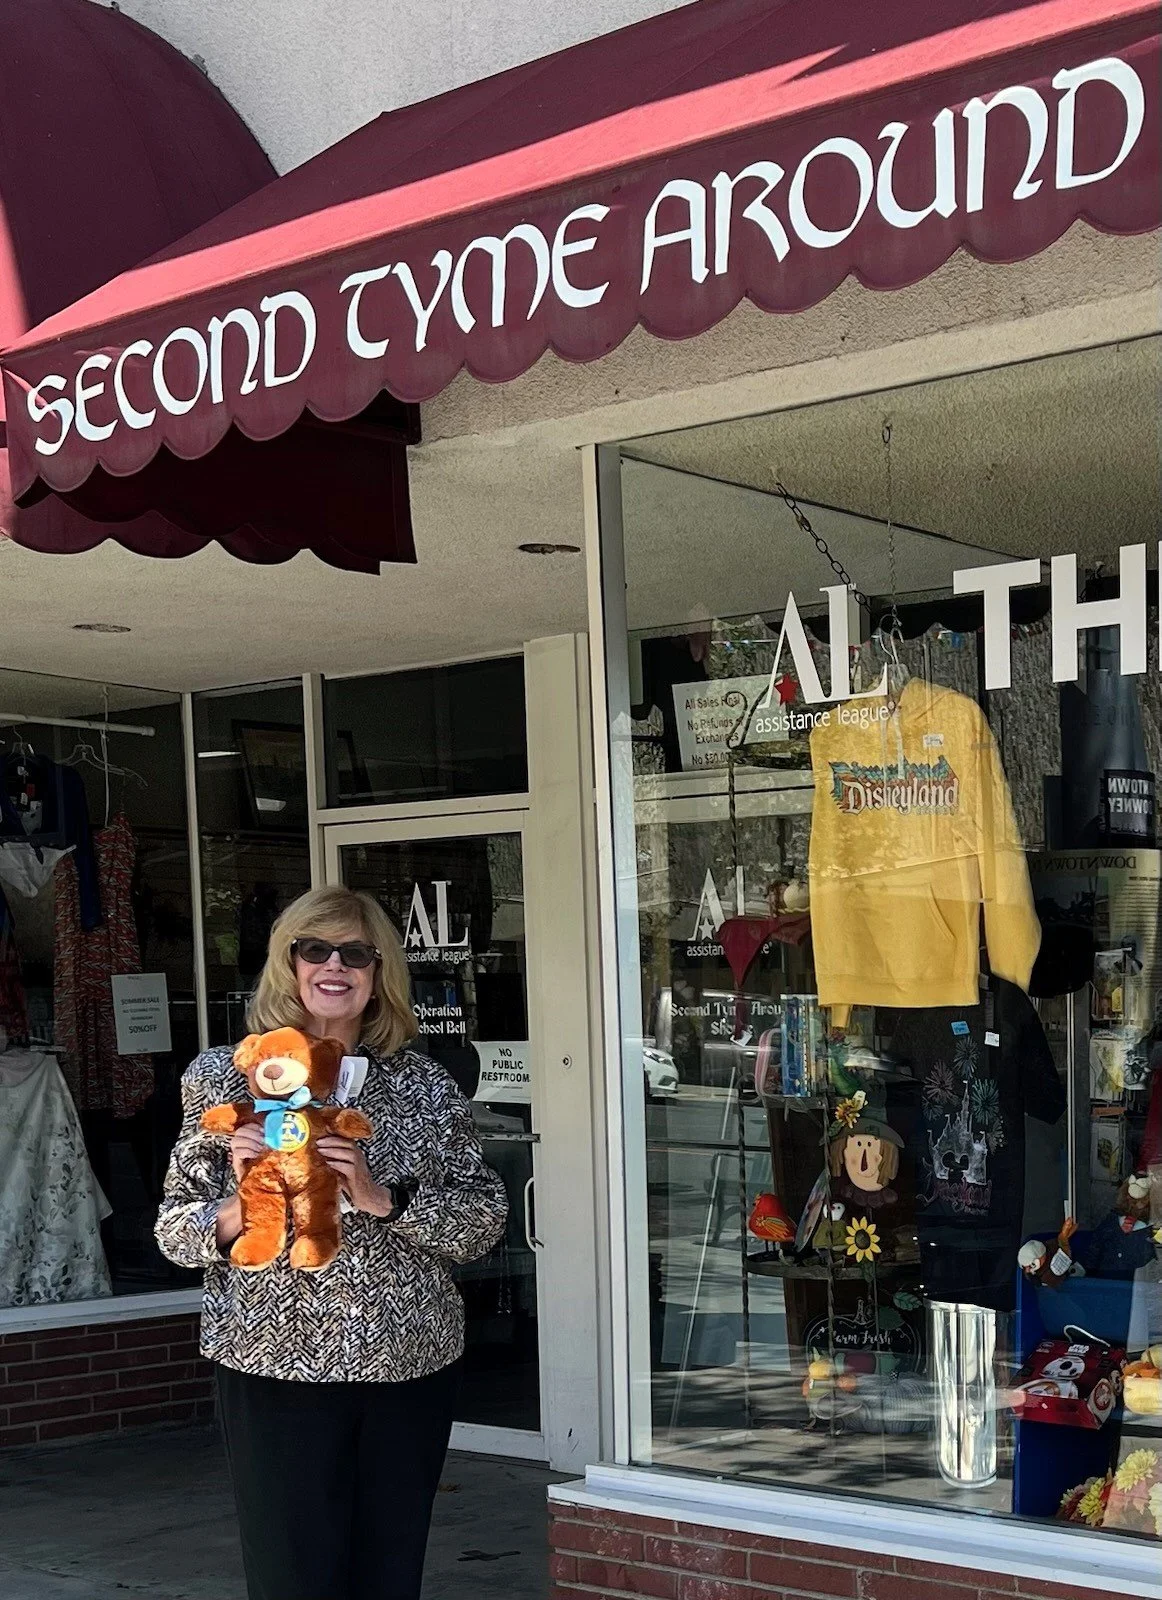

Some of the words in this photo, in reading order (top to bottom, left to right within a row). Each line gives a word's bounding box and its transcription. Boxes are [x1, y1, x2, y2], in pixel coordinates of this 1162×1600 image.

[27, 290, 317, 457] SECOND
[338, 203, 612, 360] TYME
[639, 57, 1145, 295] AROUND
[952, 539, 1162, 691] TH
[755, 584, 889, 710] AL
[685, 698, 696, 709] All
[697, 698, 719, 709] Sales
[687, 719, 699, 731] No
[755, 704, 831, 734] assistance
[691, 753, 703, 765] No
[841, 776, 959, 815] Disneyland
[402, 880, 469, 948] AL
[412, 1003, 462, 1020] Operation
[672, 1003, 711, 1017] Second
[418, 1020, 444, 1035] chool
[446, 1020, 466, 1034] Bell
[498, 1048, 513, 1057] NO
[492, 1060, 524, 1070] PUBLIC
